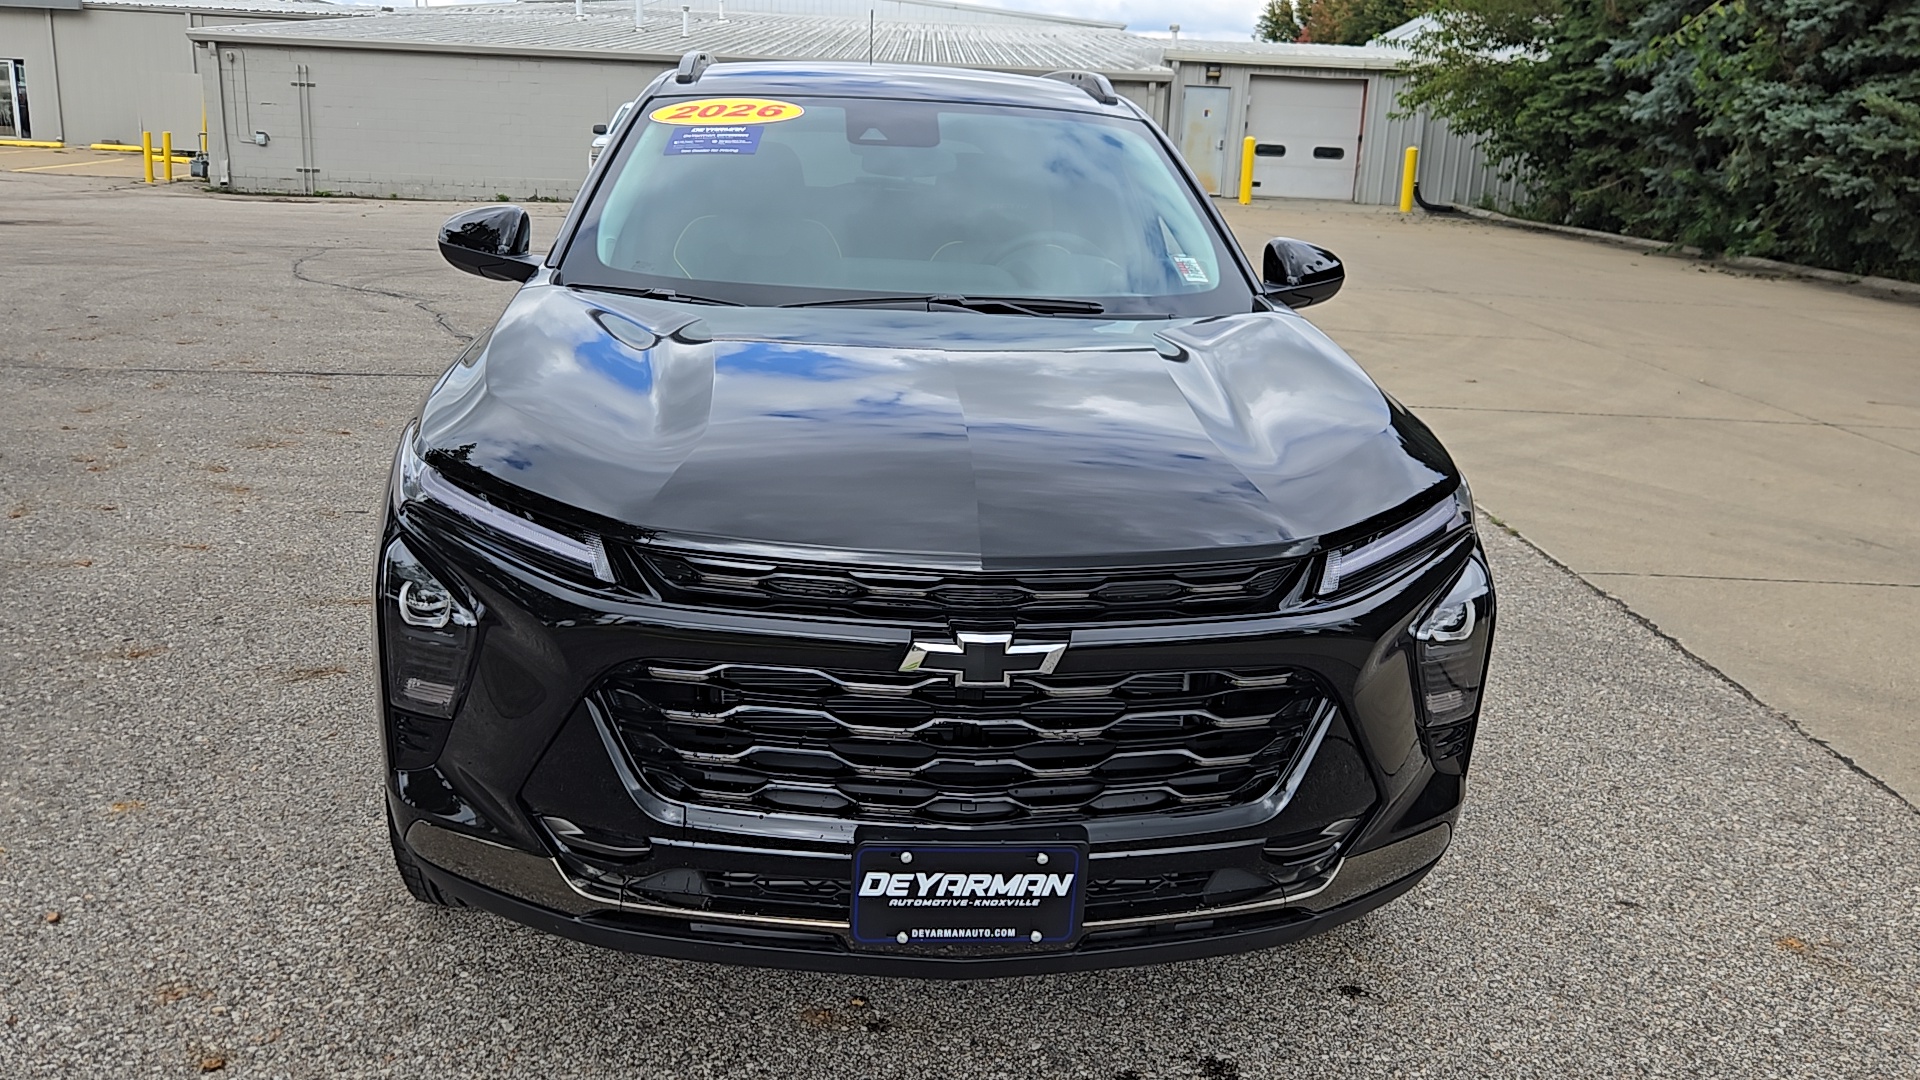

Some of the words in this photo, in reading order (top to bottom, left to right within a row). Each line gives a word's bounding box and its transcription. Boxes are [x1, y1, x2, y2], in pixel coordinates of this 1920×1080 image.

[666, 104, 787, 120] 2026
[858, 872, 1075, 896] DEYARMAN
[888, 898, 1041, 907] AUTOMOTIVE-KNOXVILLE
[911, 928, 1016, 938] DEYARMANAUTO.COM
